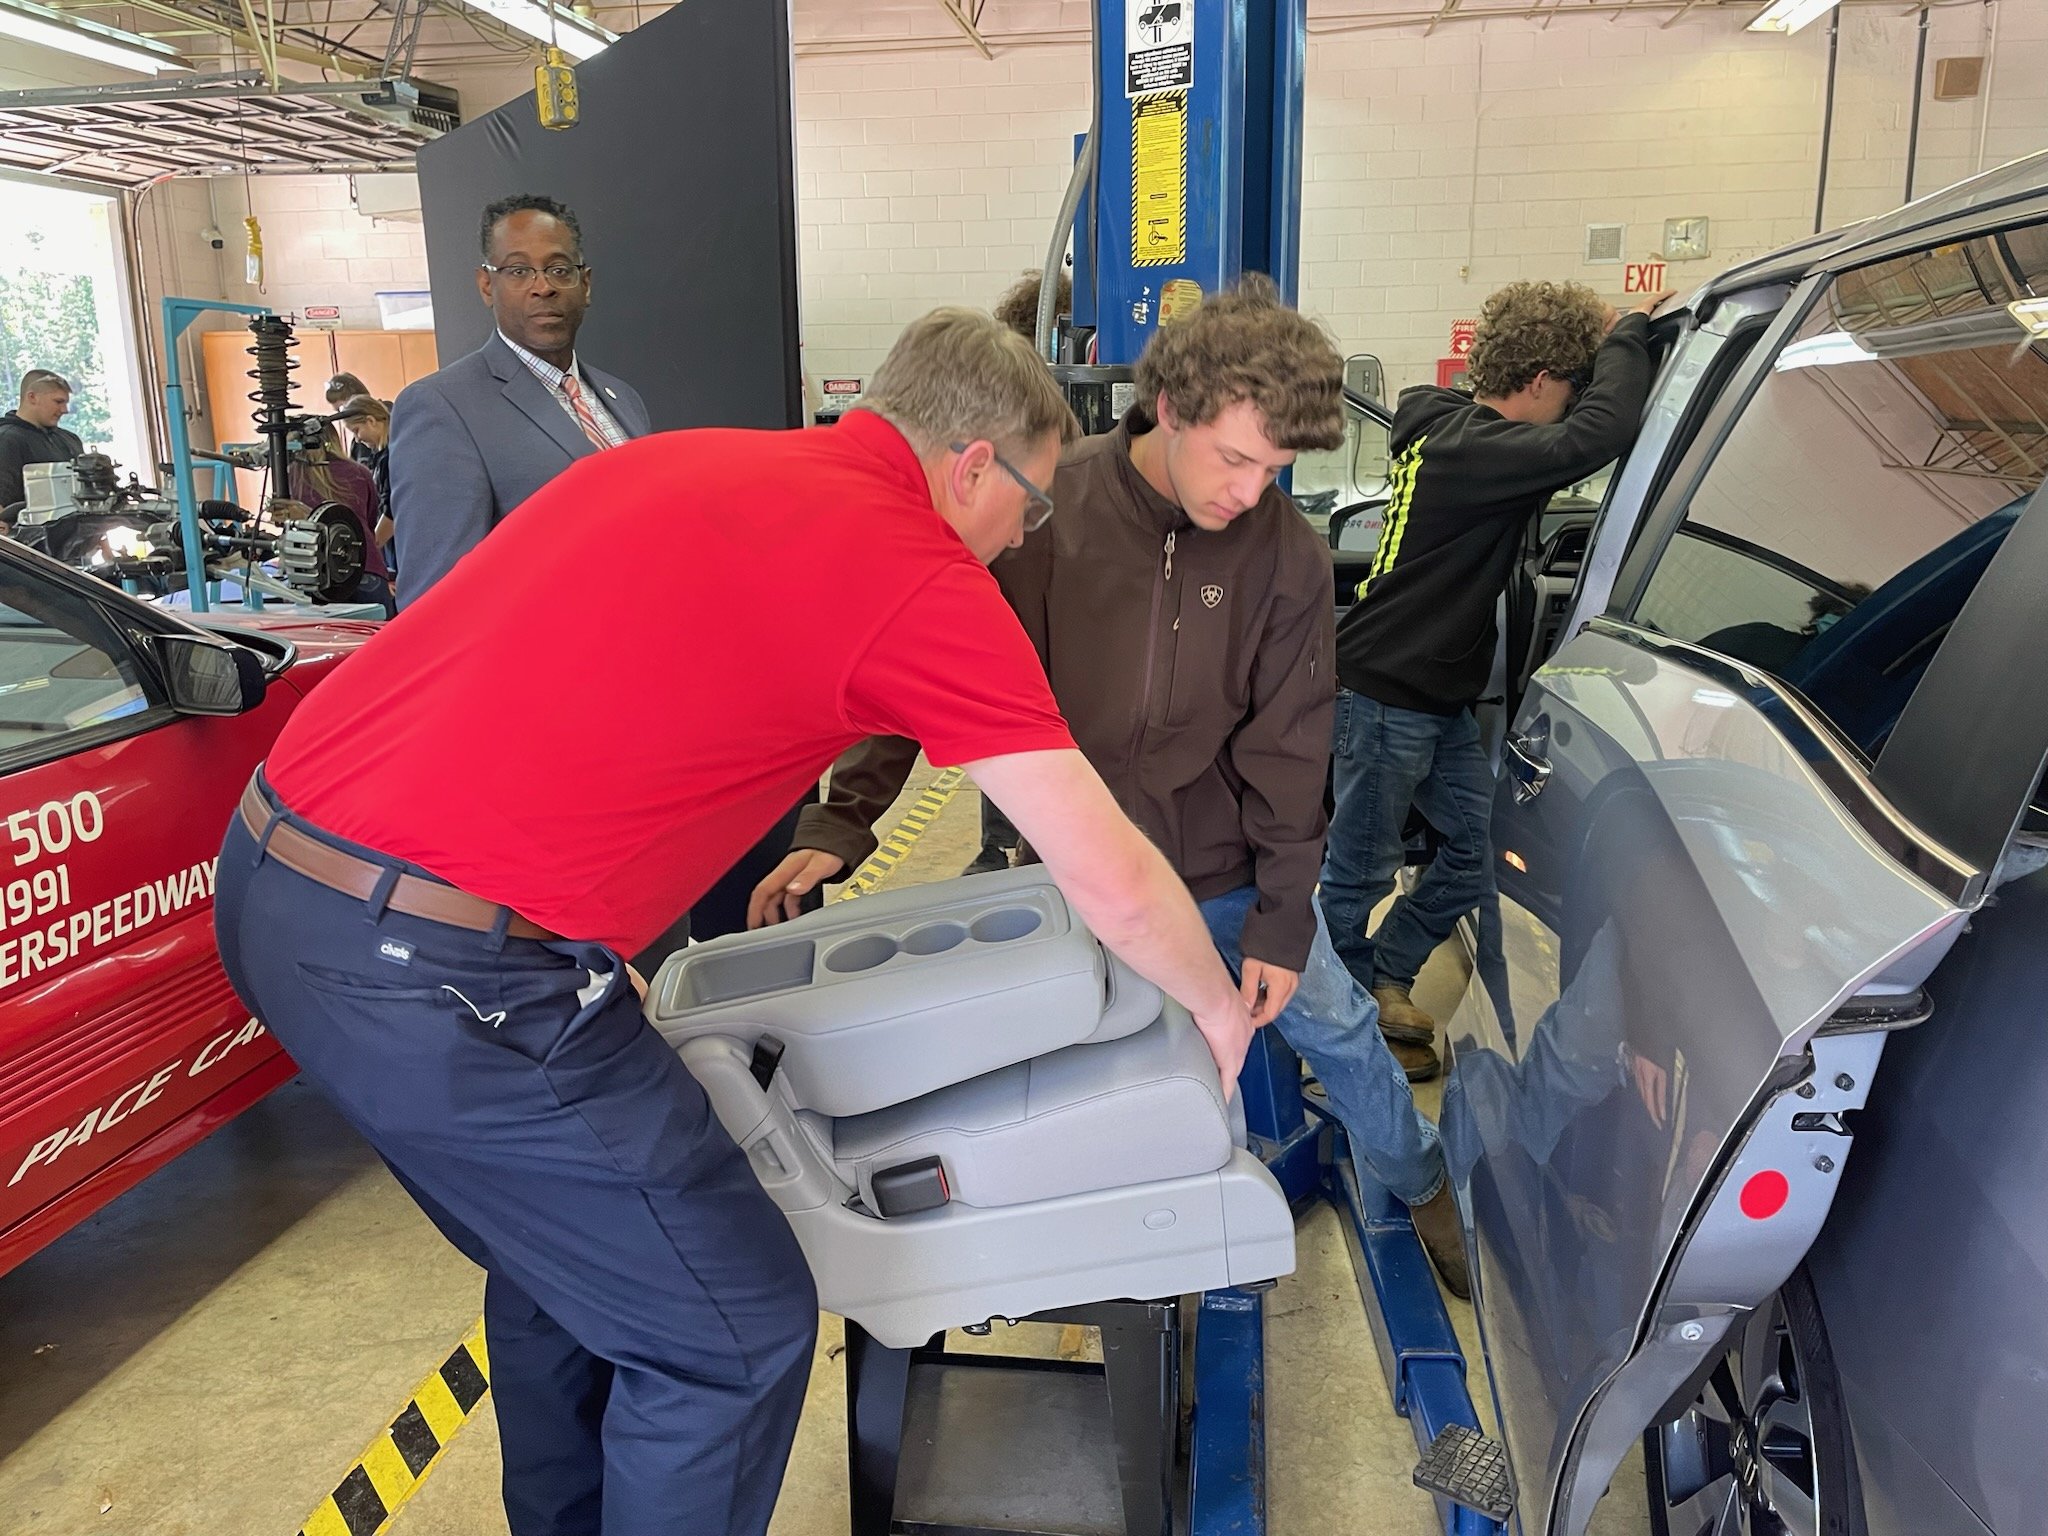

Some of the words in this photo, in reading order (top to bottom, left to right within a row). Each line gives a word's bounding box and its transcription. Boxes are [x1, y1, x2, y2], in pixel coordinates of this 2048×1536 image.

[1625, 264, 1666, 292] EXIT
[828, 383, 856, 391] DANGER
[8, 790, 104, 867] 500
[7, 1059, 183, 1188] PACE
[188, 1016, 266, 1077] CA
